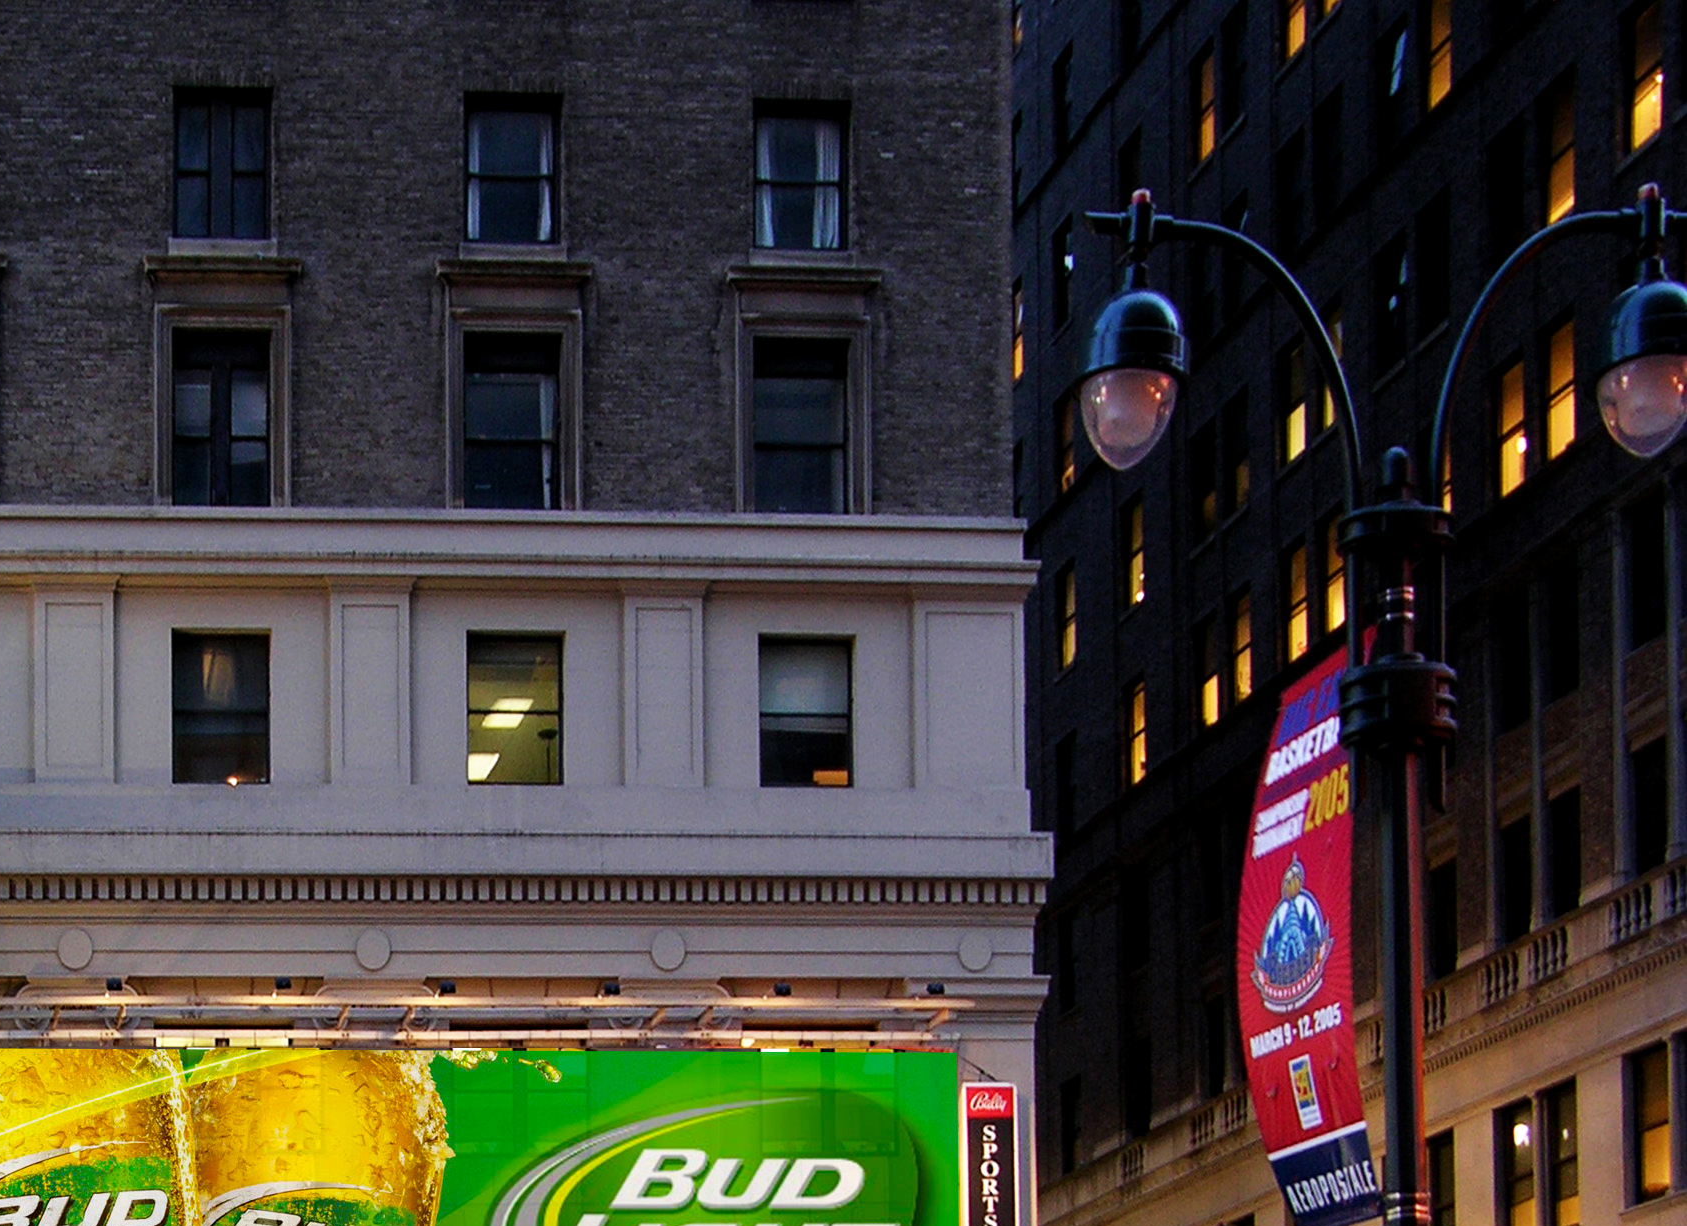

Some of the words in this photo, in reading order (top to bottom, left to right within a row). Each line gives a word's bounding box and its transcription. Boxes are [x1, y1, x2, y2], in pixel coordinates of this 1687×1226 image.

[1303, 762, 1349, 833] 2005
[1250, 1025, 1285, 1059] MARCH
[1283, 1022, 1293, 1046] 9
[1313, 1001, 1342, 1034] 2005
[969, 1090, 1007, 1113] Bally
[609, 1148, 866, 1211] BUD
[1286, 1160, 1376, 1215] AEROPOSTALE
